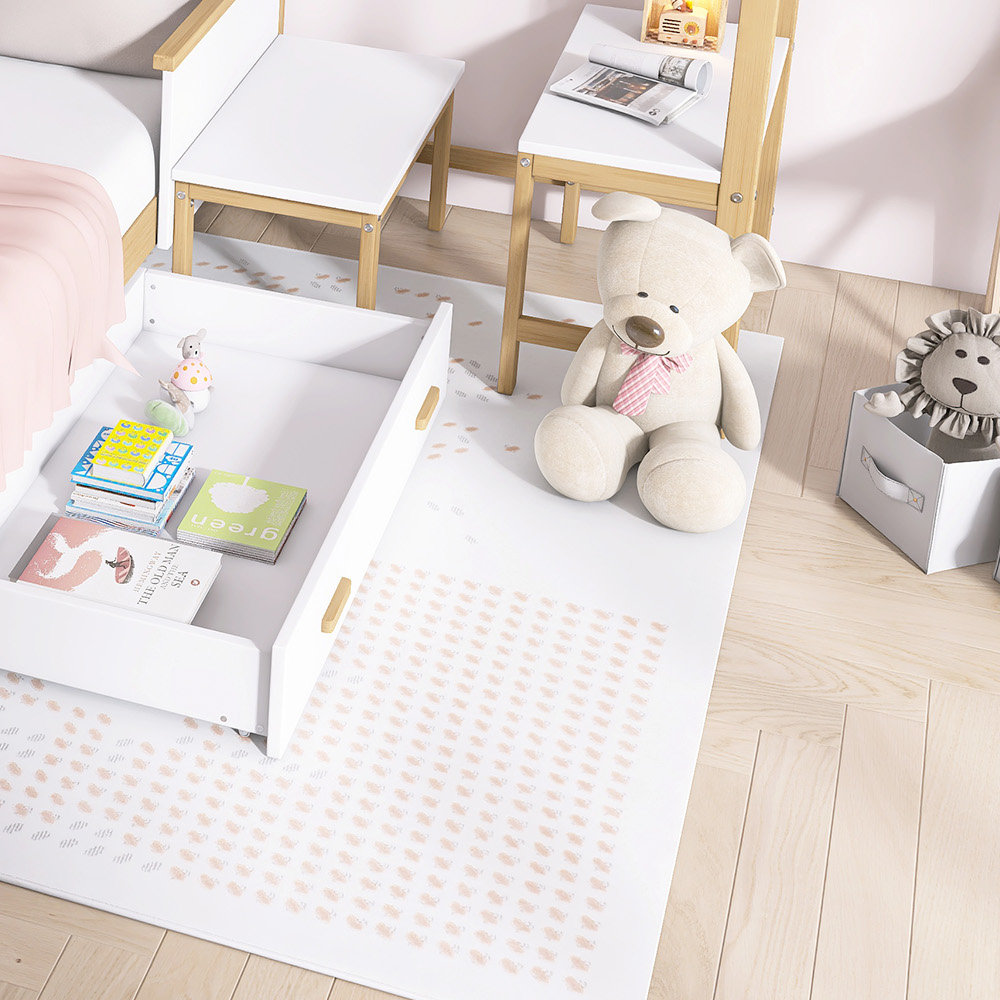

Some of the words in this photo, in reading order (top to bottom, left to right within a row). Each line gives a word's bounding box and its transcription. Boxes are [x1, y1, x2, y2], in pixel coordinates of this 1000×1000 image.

[190, 513, 281, 541] green
[136, 585, 157, 605] THE
[150, 564, 168, 585] OLD
[162, 543, 180, 565] MAN
[170, 570, 189, 589] SEA
